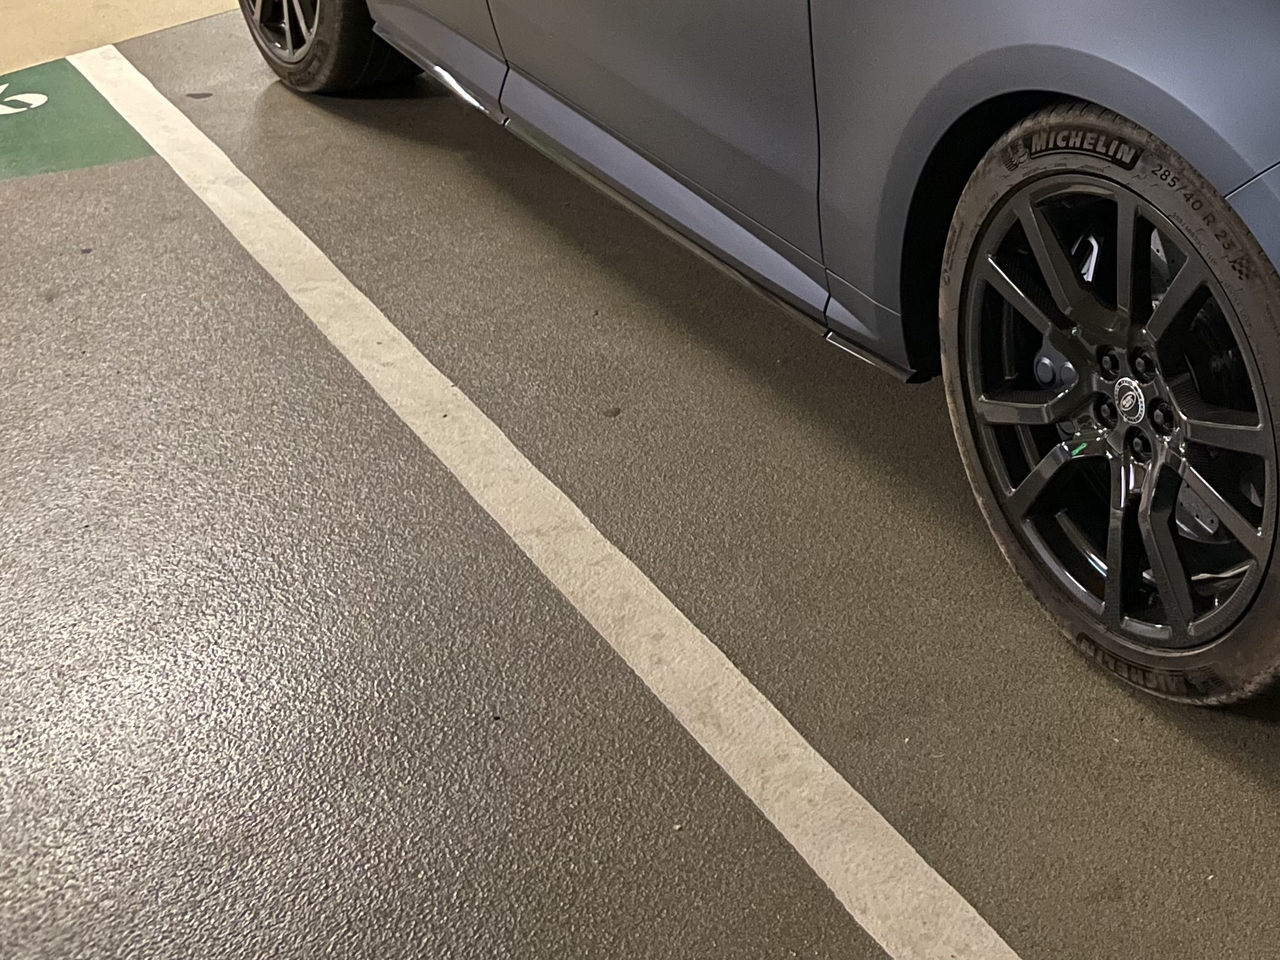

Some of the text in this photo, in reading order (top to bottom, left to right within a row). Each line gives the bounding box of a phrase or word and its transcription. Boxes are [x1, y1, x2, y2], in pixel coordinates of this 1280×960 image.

[1031, 130, 1137, 164] MICHELIN
[1151, 163, 1203, 211] 285/40
[1202, 212, 1216, 227] R
